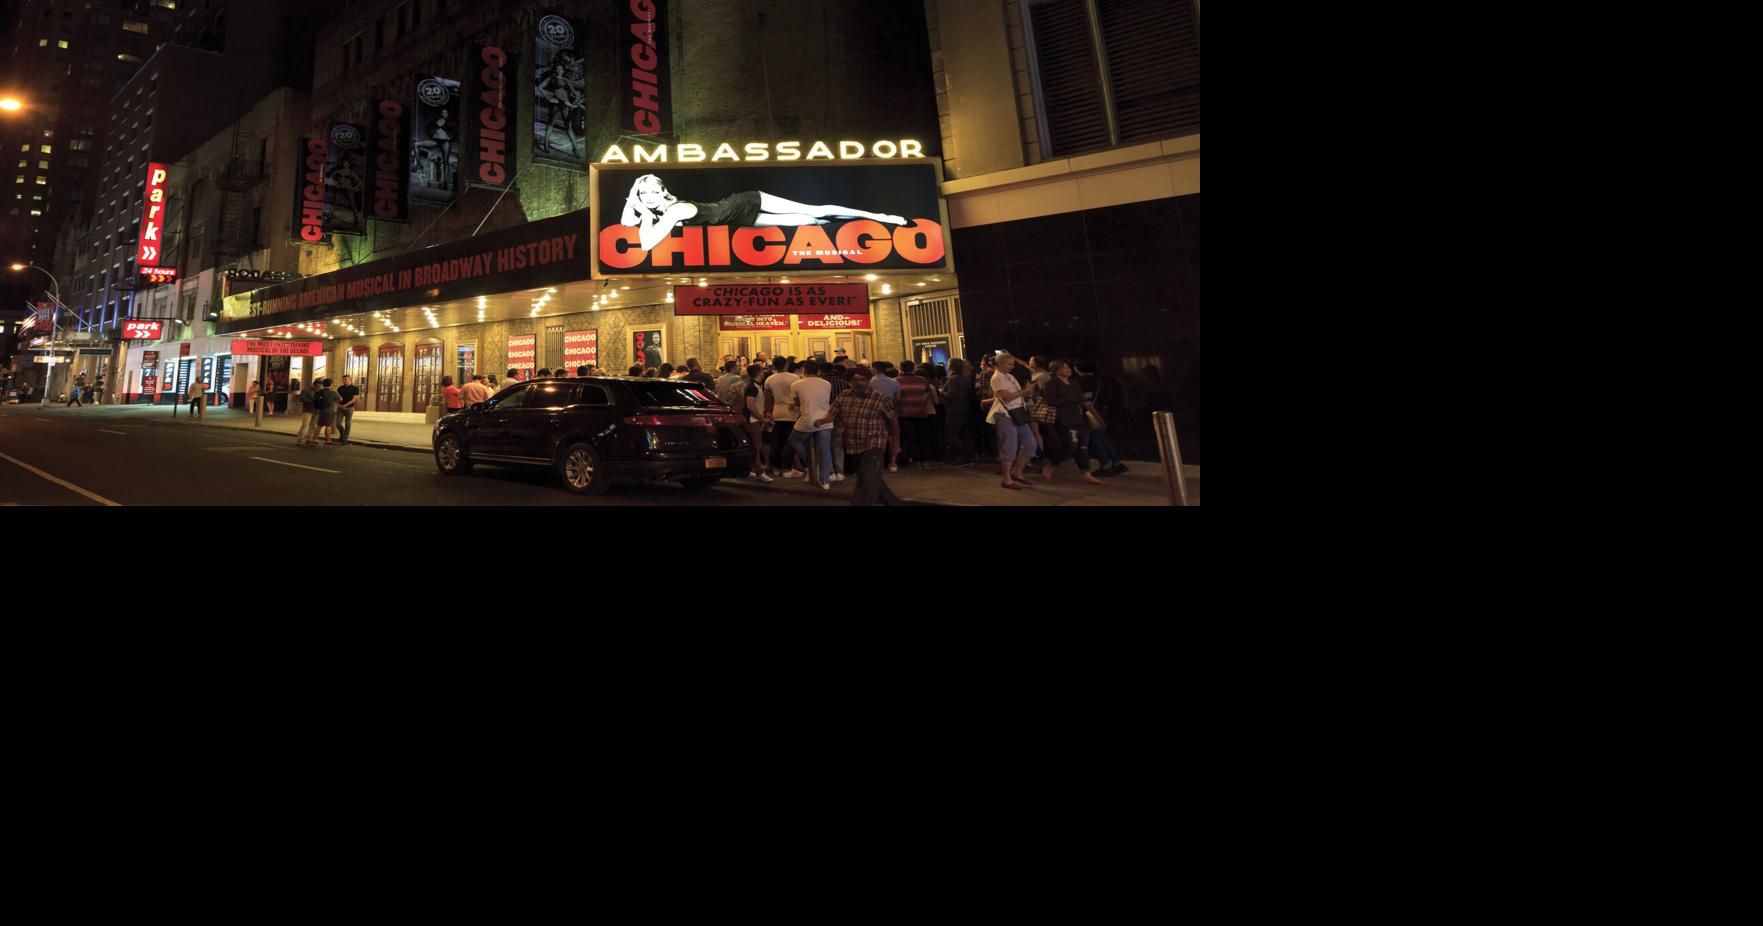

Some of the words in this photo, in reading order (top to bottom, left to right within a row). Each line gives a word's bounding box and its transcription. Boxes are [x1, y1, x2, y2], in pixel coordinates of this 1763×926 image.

[548, 24, 565, 34] 20
[425, 86, 441, 95] 20
[479, 46, 508, 185] CHICAGO
[601, 139, 925, 163] AMBASSADOR
[374, 100, 402, 218] CHICAGO
[301, 138, 328, 242] CHICAGO
[144, 169, 167, 240] park
[599, 218, 945, 268] CHICAGO
[300, 283, 345, 309] AMERICAN
[346, 272, 394, 300] MUSICAL
[398, 269, 412, 290] IN
[414, 252, 493, 288] BROADWAY
[497, 234, 577, 272] HISTORY
[788, 286, 802, 296] IS
[807, 286, 826, 296] AS
[692, 297, 779, 307] CRAZY-FUN
[785, 296, 804, 306] AS
[127, 322, 159, 330] park
[508, 339, 535, 347] CHICAGO
[565, 334, 597, 343] CHICAGO
[508, 350, 535, 358] CHICAGO
[565, 347, 597, 356] CHICAGO
[508, 362, 535, 370] CHICAGO
[565, 360, 597, 368] CHICAGO
